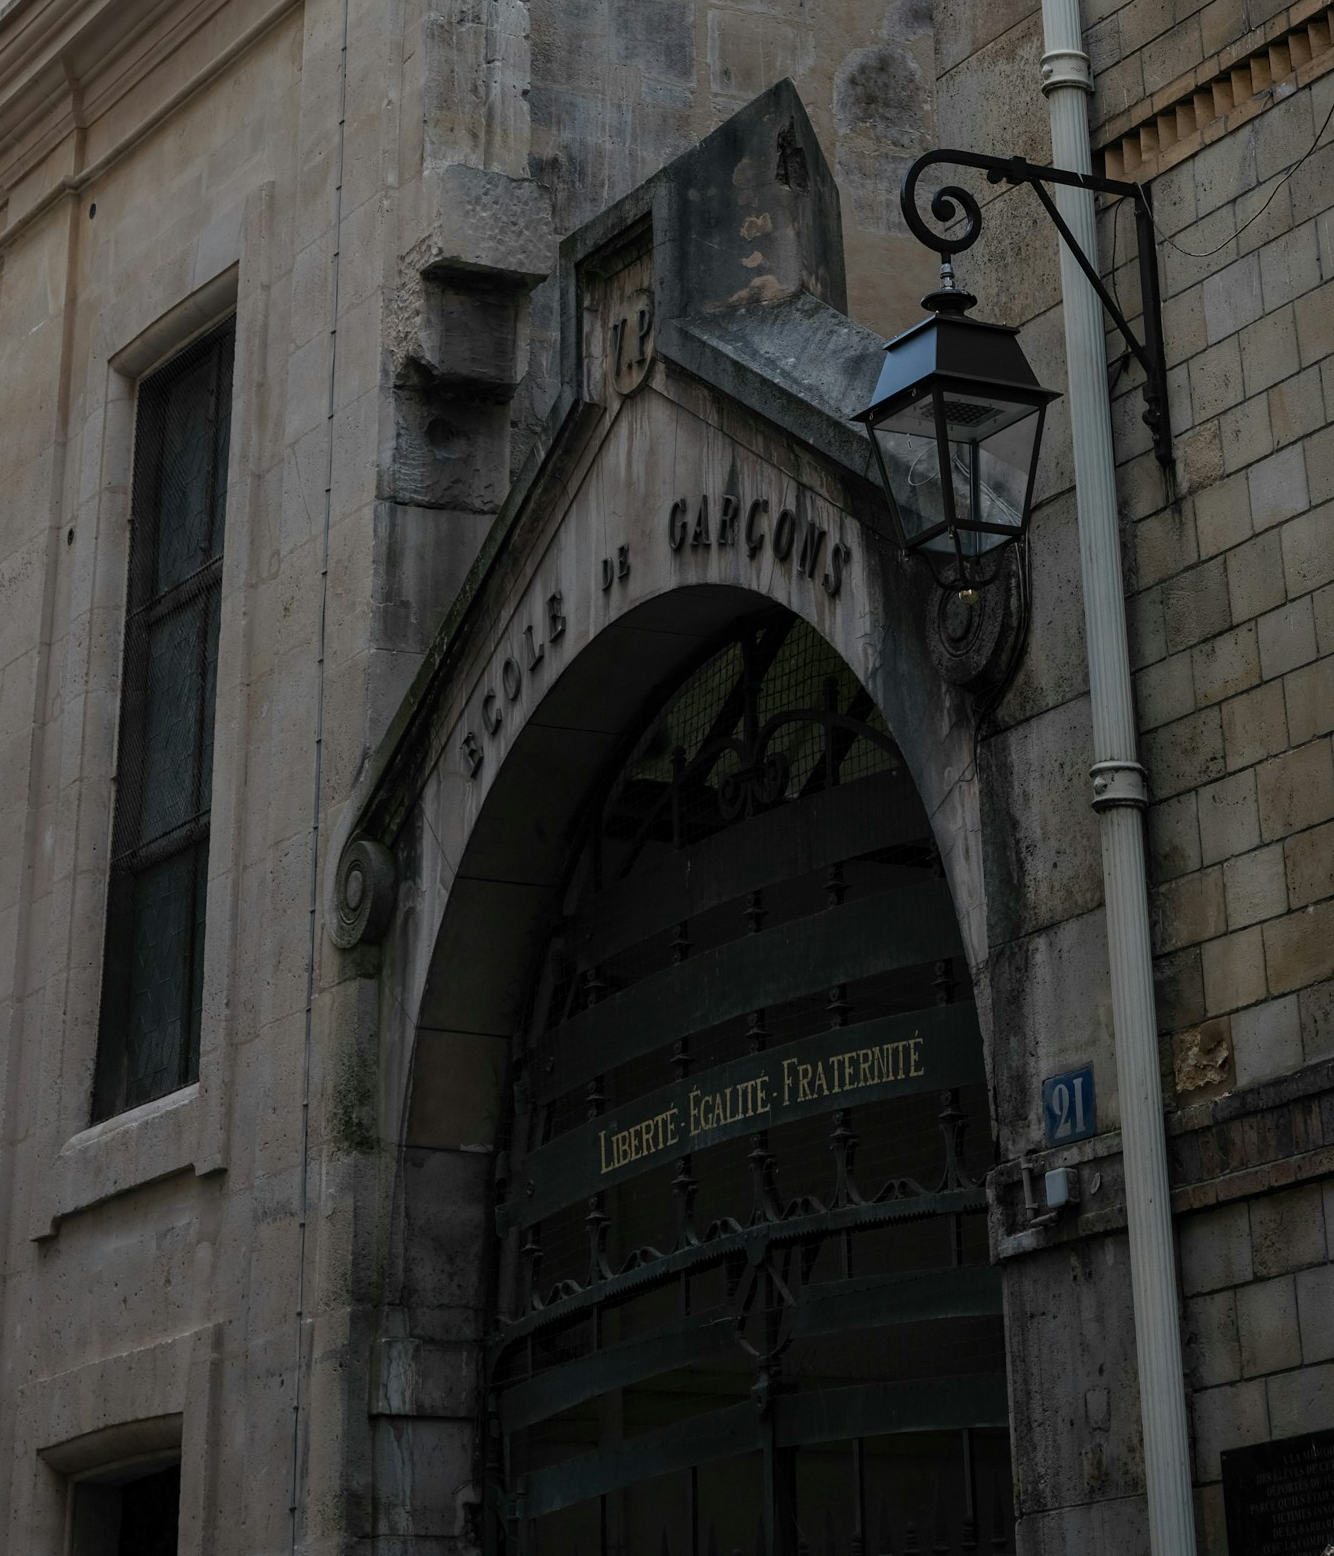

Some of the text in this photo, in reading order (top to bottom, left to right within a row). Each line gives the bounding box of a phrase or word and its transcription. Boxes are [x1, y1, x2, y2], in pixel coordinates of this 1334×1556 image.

[459, 494, 852, 779] ECOLE DE GARÇONS
[598, 1102, 679, 1175] LIBERTÉ
[688, 1070, 771, 1137] ÉGALITÉ
[782, 1029, 924, 1106] FRATERNITÉ
[1052, 1077, 1086, 1139] 21
